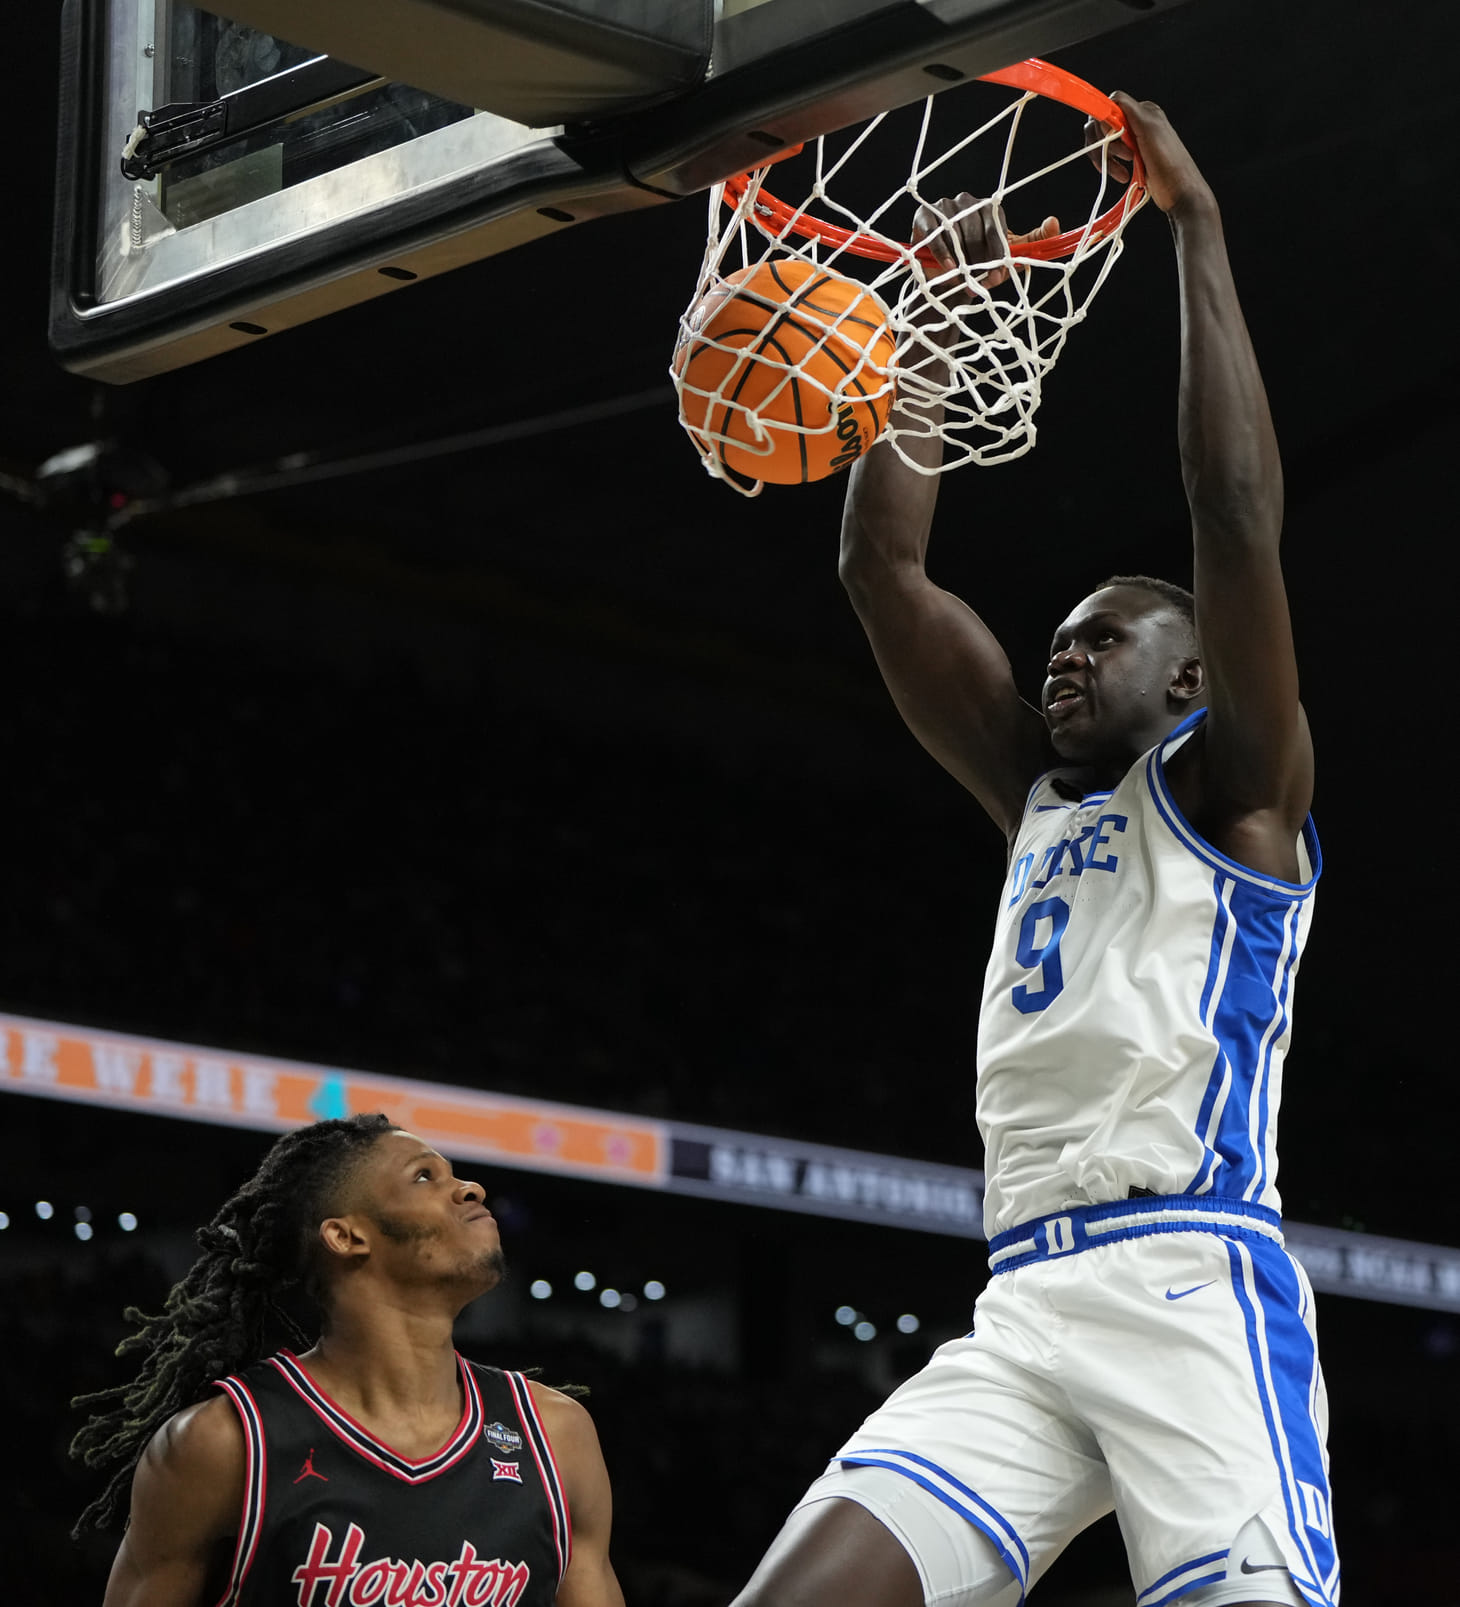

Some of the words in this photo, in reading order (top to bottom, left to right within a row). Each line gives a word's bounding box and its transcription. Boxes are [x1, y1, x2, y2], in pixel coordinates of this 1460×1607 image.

[1012, 896, 1069, 1014] 9
[91, 1042, 278, 1115] WERE
[488, 1430, 504, 1441] FINAL
[504, 1434, 520, 1444] FOUR
[291, 1522, 530, 1607] Houston
